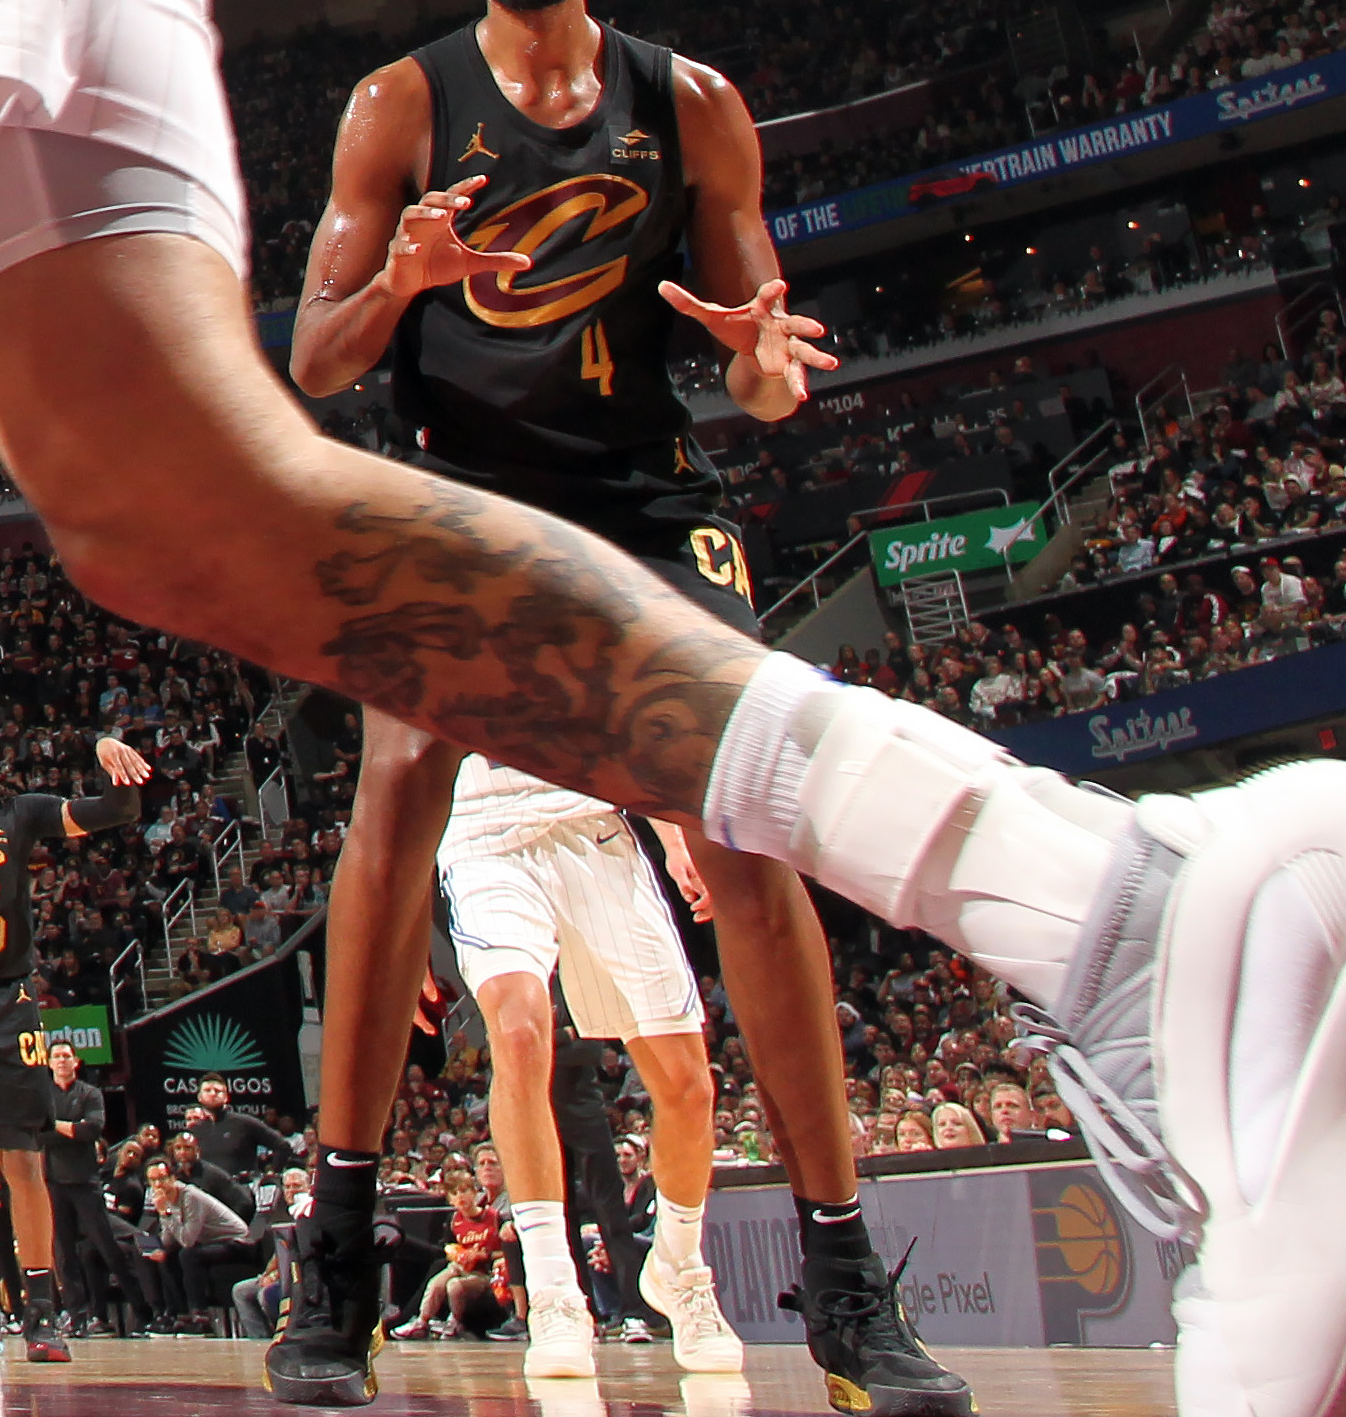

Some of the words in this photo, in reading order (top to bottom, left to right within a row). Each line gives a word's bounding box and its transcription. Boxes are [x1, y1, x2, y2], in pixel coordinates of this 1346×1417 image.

[611, 147, 660, 161] CLIFFS
[776, 214, 798, 240] OF
[802, 203, 841, 233] THE
[1058, 110, 1174, 165] WARRANTY
[580, 319, 613, 396] 4
[885, 531, 967, 572] Sprite
[163, 1077, 272, 1093] CASIGOS
[707, 1218, 803, 1322] PLAYO
[938, 1272, 994, 1315] Pixel
